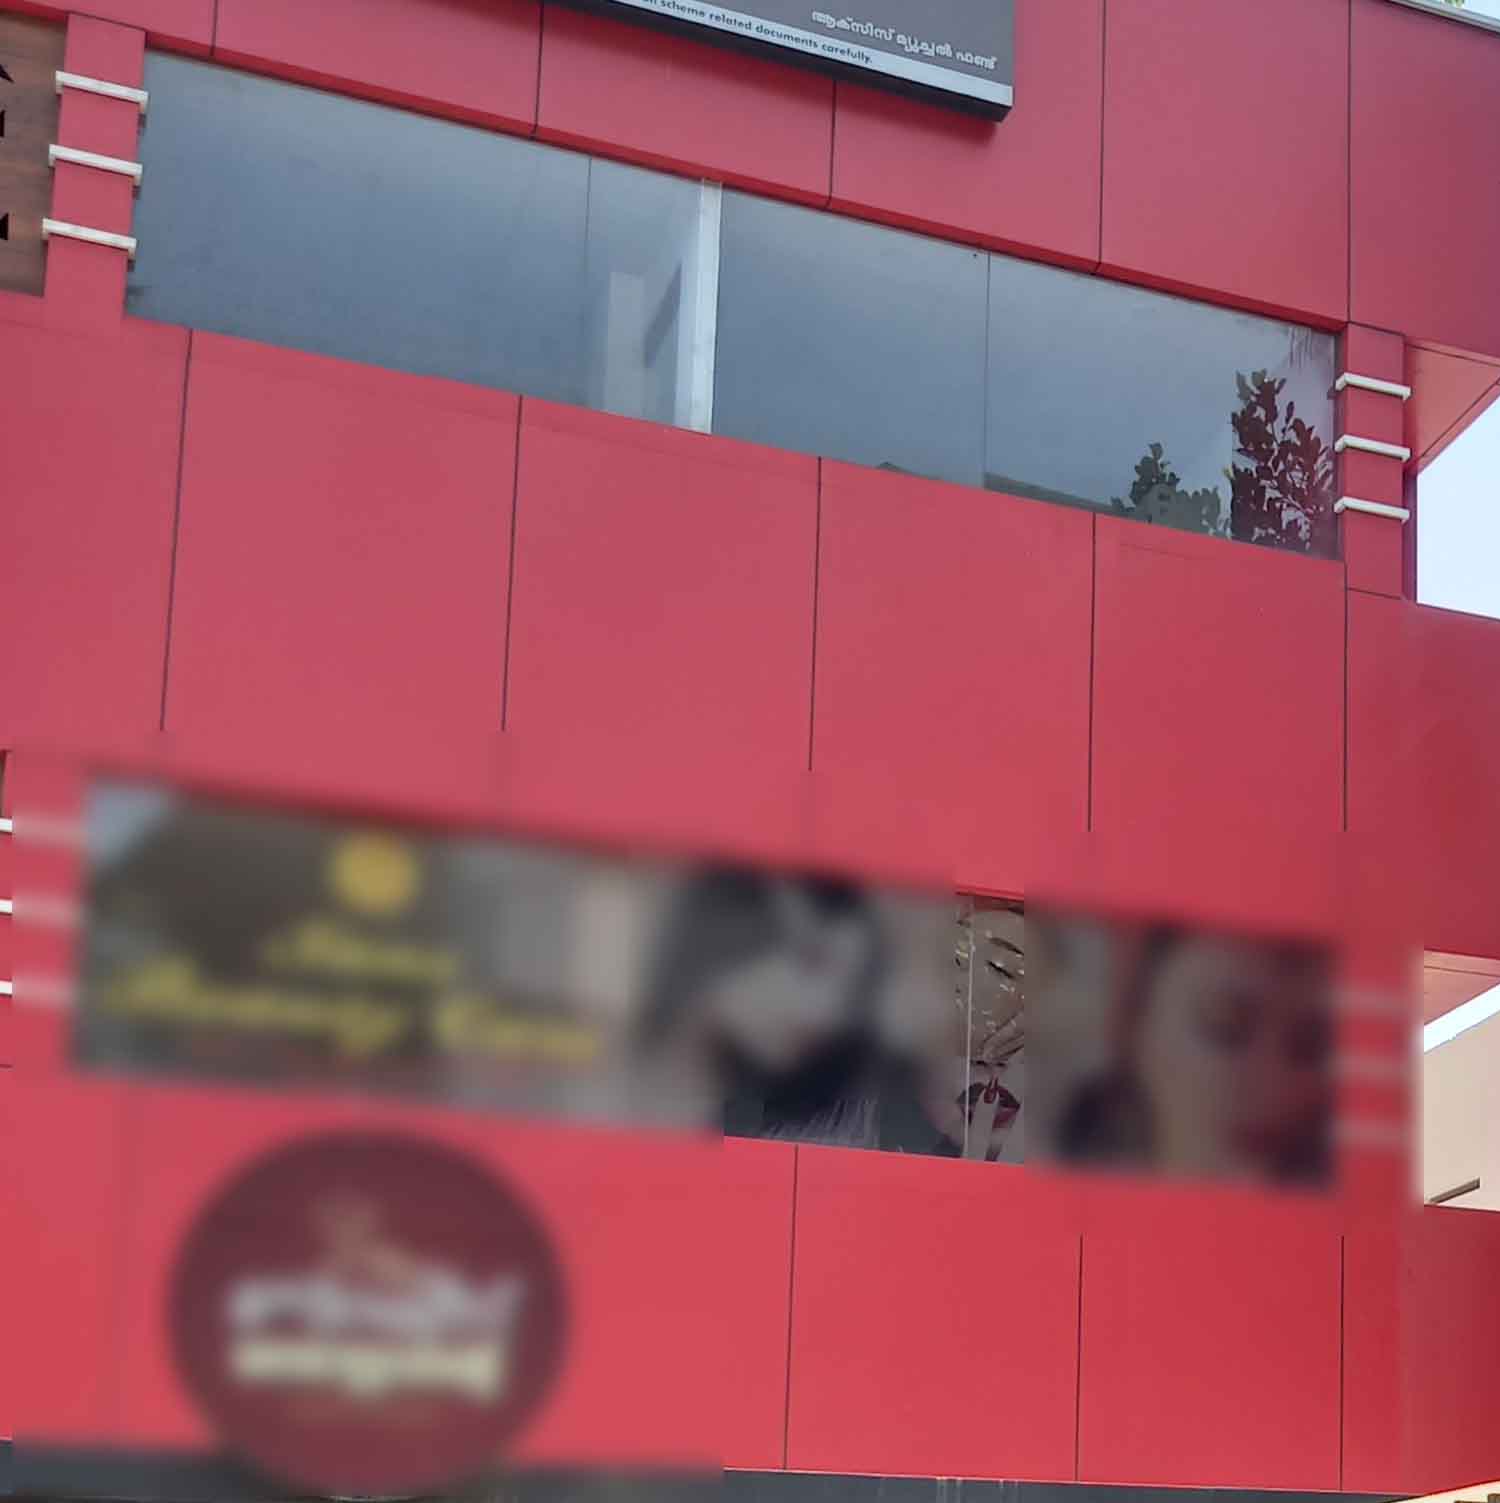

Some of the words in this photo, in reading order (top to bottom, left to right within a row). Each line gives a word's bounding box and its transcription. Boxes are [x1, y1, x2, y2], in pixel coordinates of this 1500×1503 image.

[709, 13, 752, 31] related
[755, 24, 818, 49] documents
[822, 43, 872, 64] carefully.
